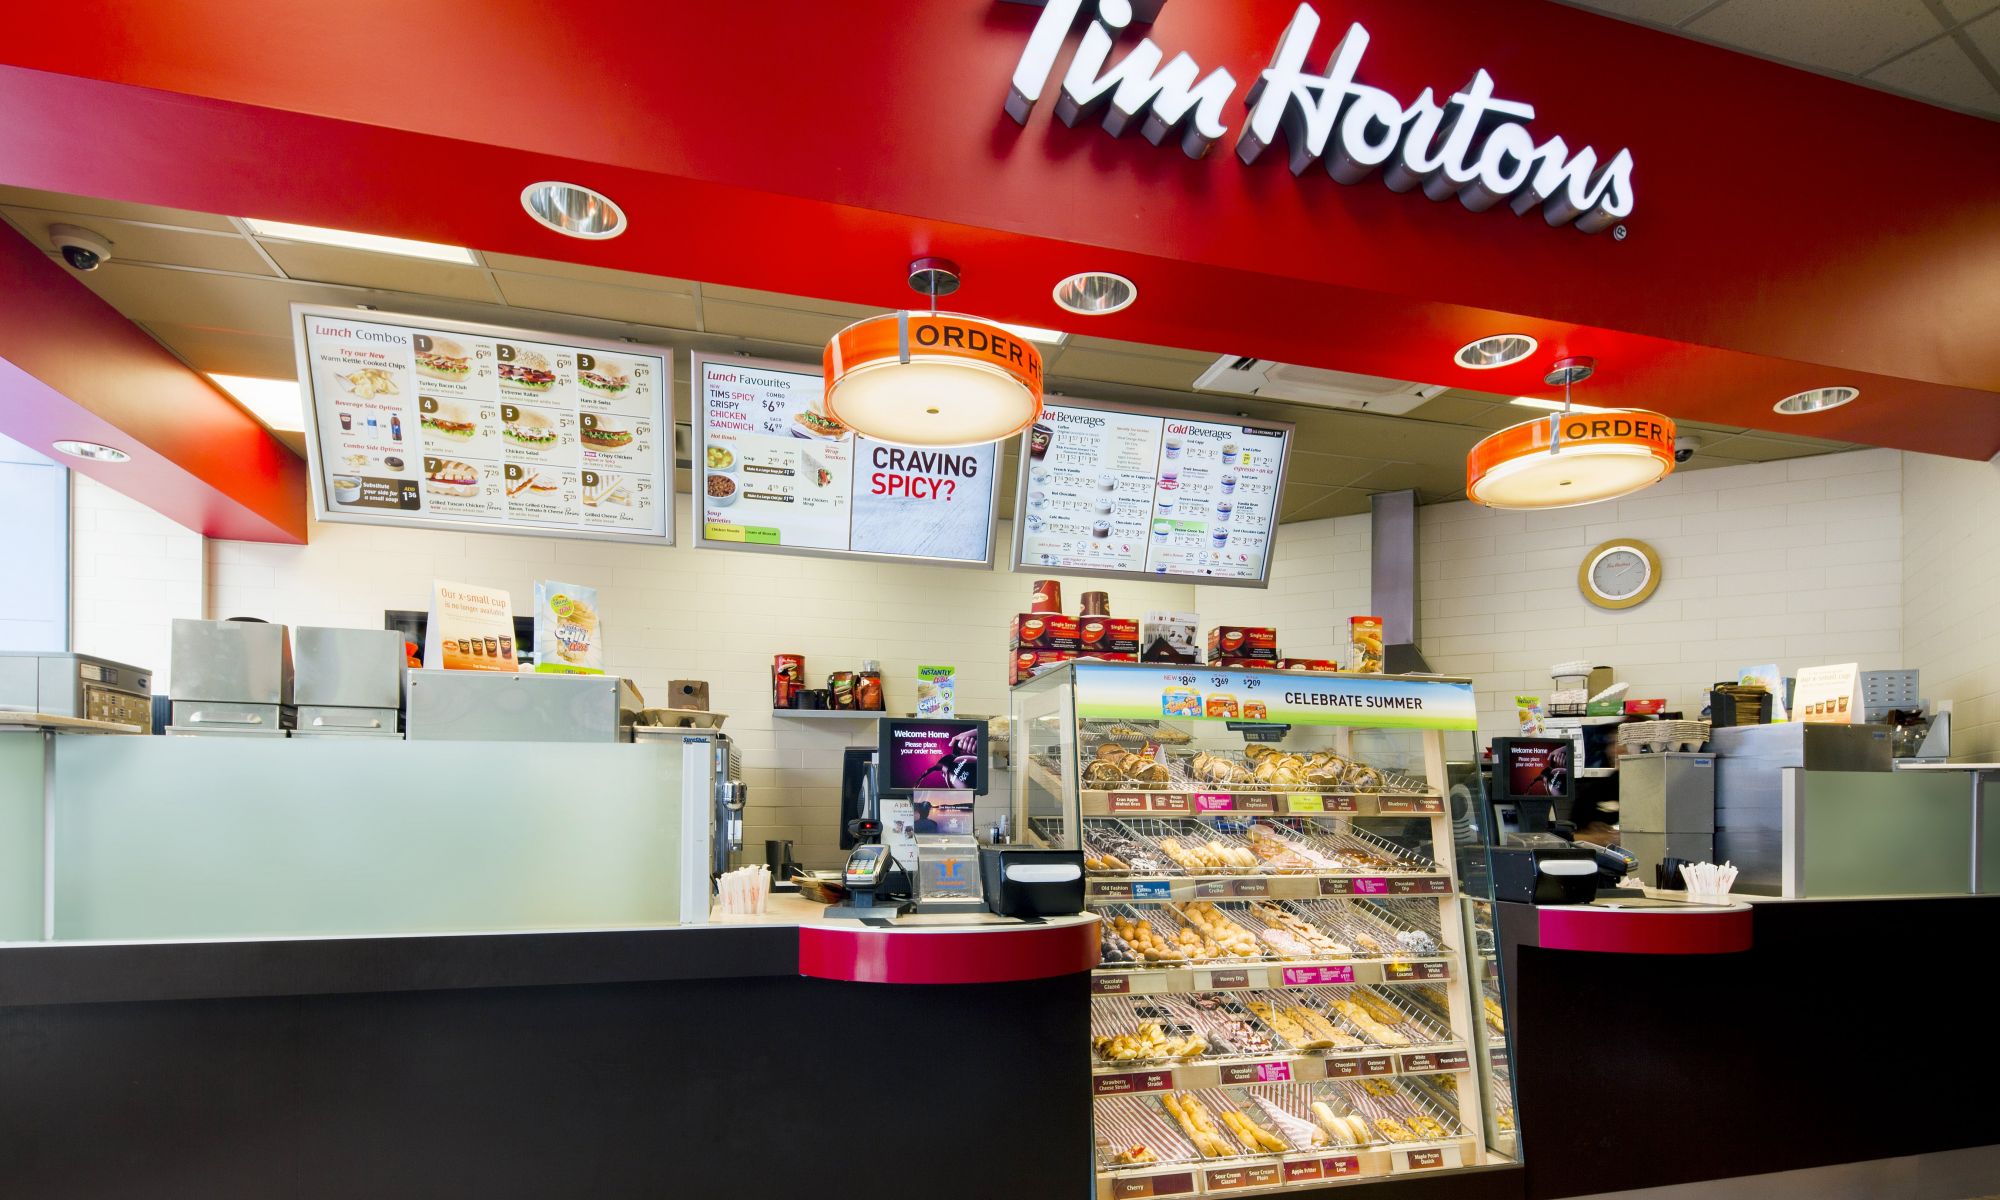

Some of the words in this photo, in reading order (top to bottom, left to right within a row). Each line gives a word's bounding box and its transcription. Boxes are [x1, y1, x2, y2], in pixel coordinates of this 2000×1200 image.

[1012, 0, 1237, 139] Tim
[1250, 6, 1634, 219] Hortons
[315, 325, 352, 338] Lunch
[355, 329, 407, 345] Combos
[418, 338, 425, 348] 1
[915, 324, 1024, 368] ORDER
[340, 348, 352, 356] Try
[502, 348, 509, 358] 2
[320, 354, 341, 362] Warm
[342, 357, 361, 365] Kettle
[363, 360, 387, 368] Cooked
[582, 358, 589, 367] 3
[707, 370, 736, 383] Lunch
[739, 374, 790, 390] Favourites
[710, 390, 730, 398] TIMS
[732, 392, 755, 401] SPICY
[335, 400, 362, 409] Beverage
[379, 404, 402, 412] Options
[424, 400, 432, 410] 4
[710, 400, 740, 410] CRISPY
[506, 409, 513, 418] 5
[710, 410, 747, 421] CHICKEN
[584, 416, 591, 426] 6
[1040, 410, 1056, 421] Hot
[1057, 412, 1105, 428] Beverages
[710, 420, 754, 431] SANDWICH
[1167, 423, 1188, 434] Cold
[1188, 426, 1232, 441] Beverages
[1566, 419, 1662, 443] ORDER
[505, 448, 524, 456] Chicken
[598, 452, 613, 460] Crispy
[429, 460, 436, 470] 7
[872, 446, 978, 478] CRAVING
[509, 468, 516, 477] 8
[586, 474, 594, 483] 9
[362, 482, 390, 490] Substitute
[870, 472, 956, 502] SPICY?
[441, 588, 456, 599] Our
[458, 592, 490, 605] x-small
[492, 598, 506, 608] cup
[460, 604, 478, 612] longer
[921, 668, 952, 676] INSTANTLY
[1285, 692, 1363, 708] CELEBRATE
[1366, 696, 1423, 710] SUMMER
[894, 730, 927, 738] Welcome
[928, 731, 950, 739] Home
[1126, 1184, 1144, 1192] Cherry
